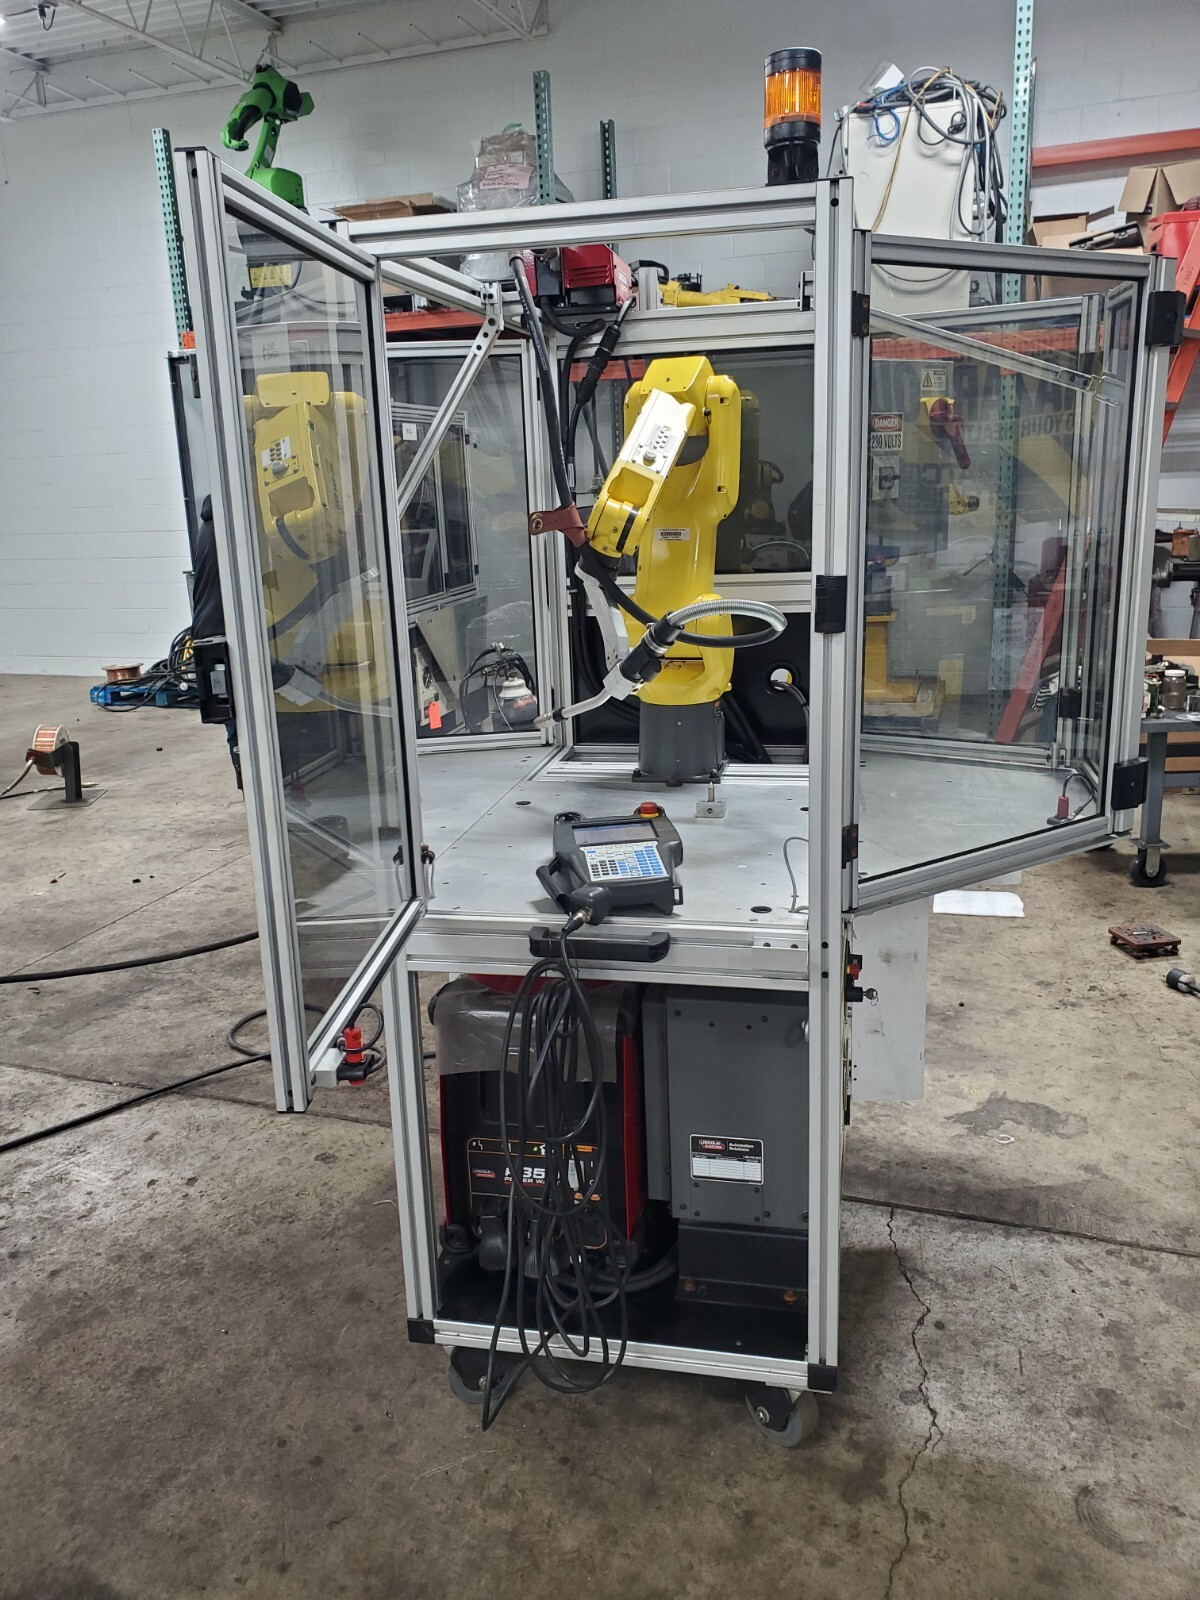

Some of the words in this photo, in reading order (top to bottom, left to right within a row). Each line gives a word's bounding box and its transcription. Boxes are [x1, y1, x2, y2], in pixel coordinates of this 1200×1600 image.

[874, 418, 899, 428] DANGER
[871, 433, 883, 449] 230
[884, 433, 901, 449] VOLTS
